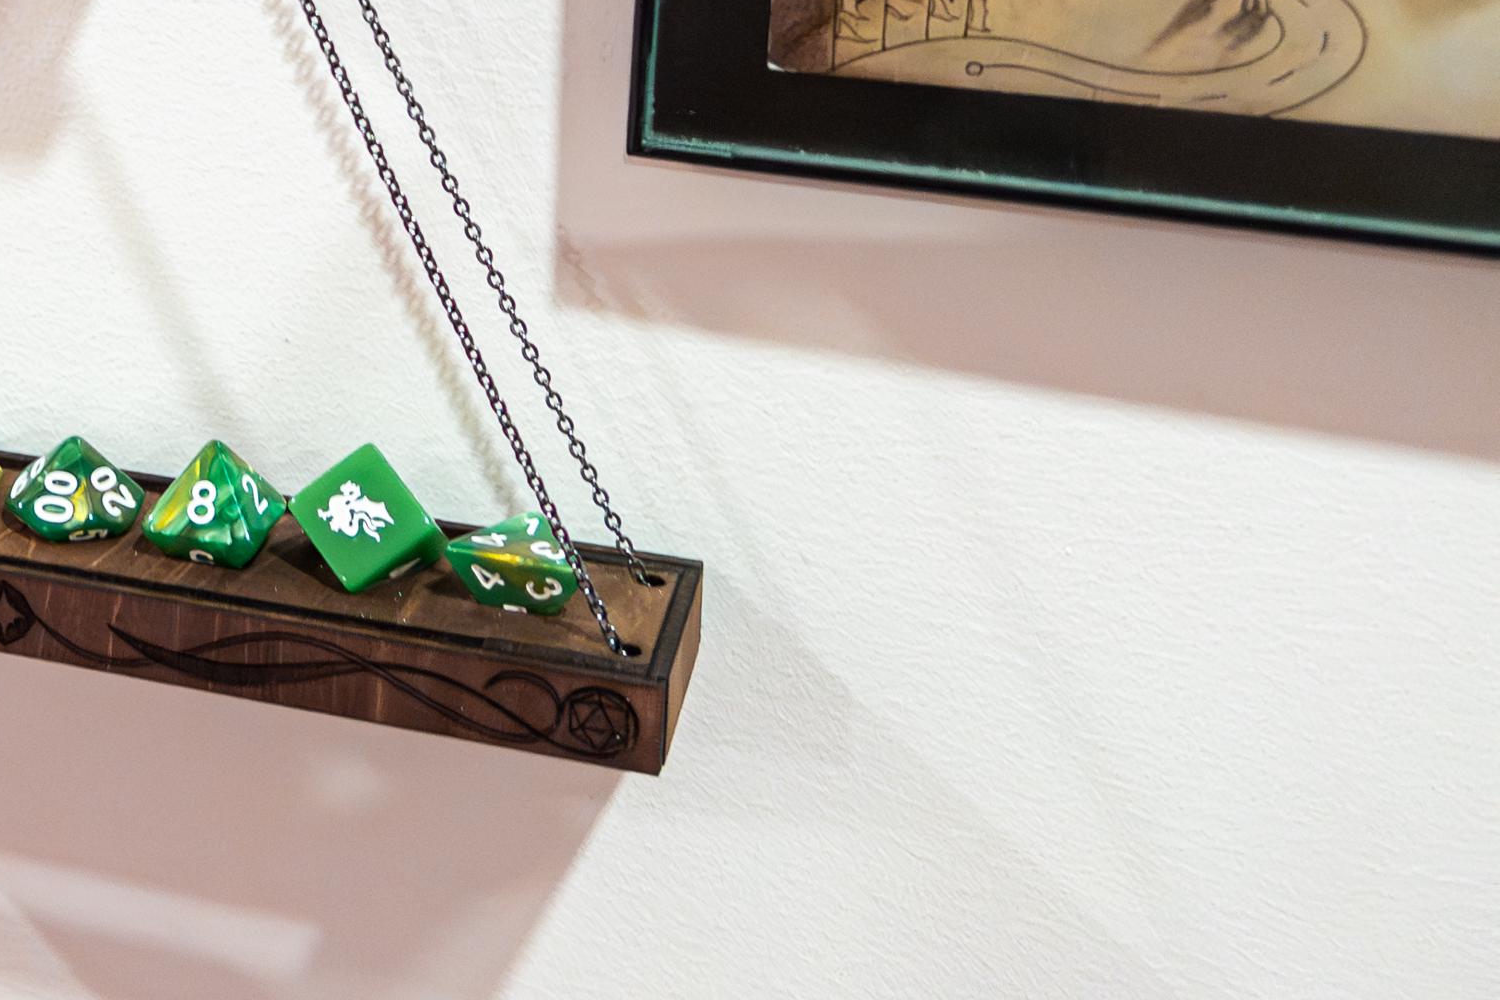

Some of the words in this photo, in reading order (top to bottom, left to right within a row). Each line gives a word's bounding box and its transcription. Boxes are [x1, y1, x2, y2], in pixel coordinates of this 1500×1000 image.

[33, 470, 78, 524] 00
[187, 480, 217, 525] 8
[241, 473, 269, 515] 2
[470, 563, 506, 591] 4
[525, 576, 563, 601] 3
